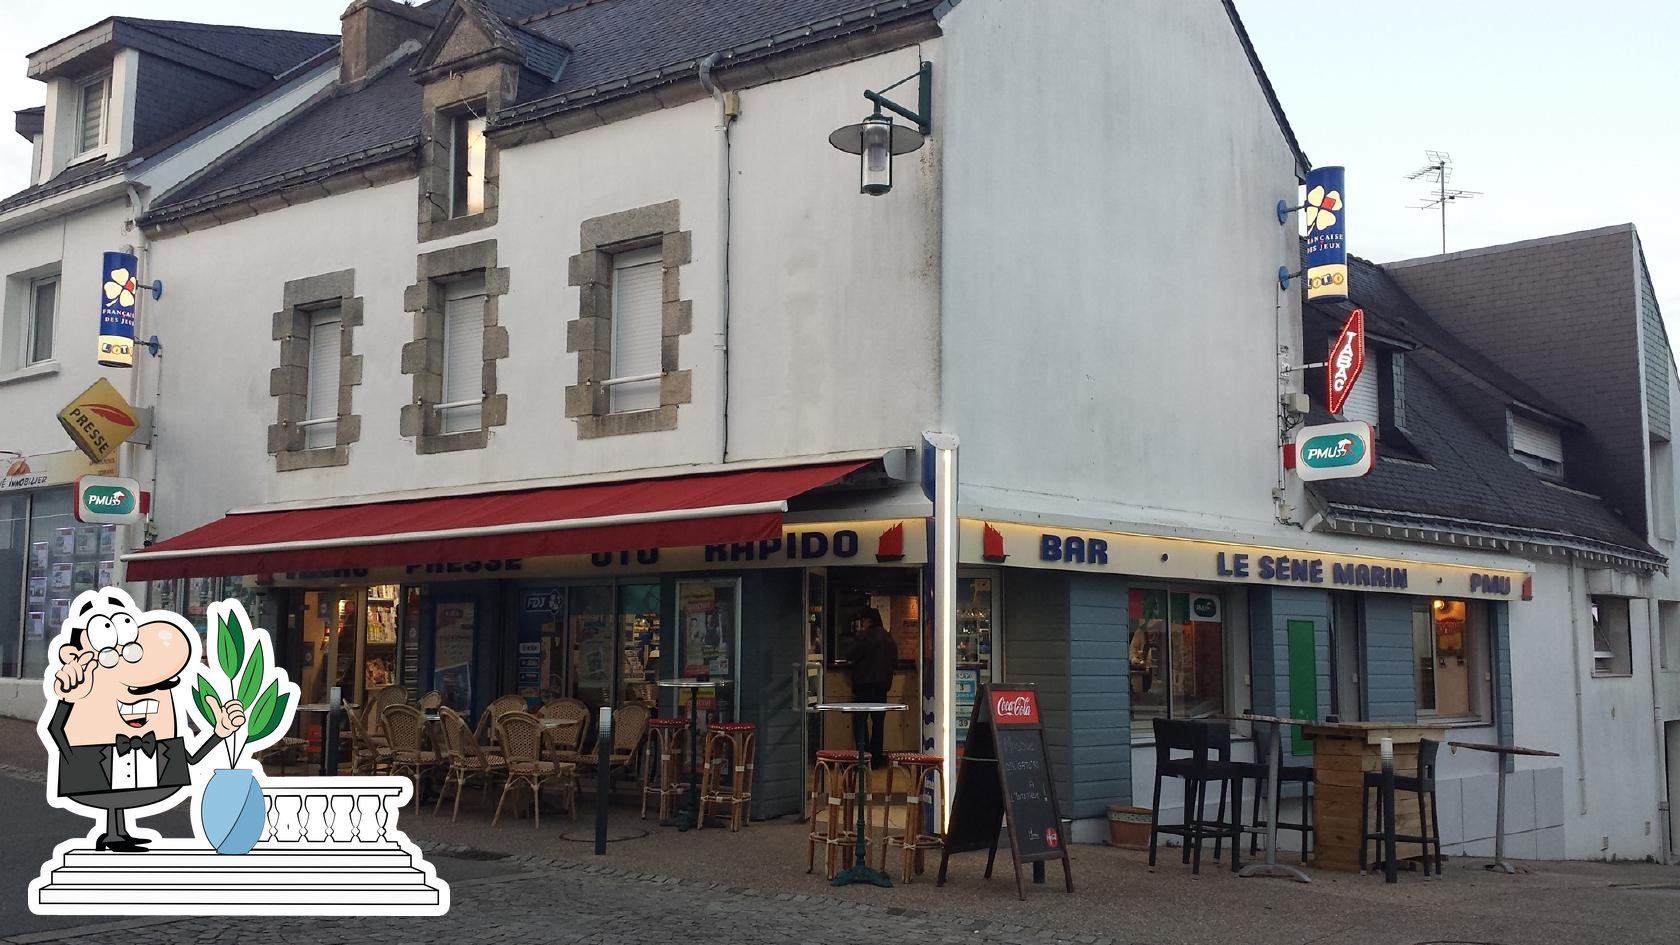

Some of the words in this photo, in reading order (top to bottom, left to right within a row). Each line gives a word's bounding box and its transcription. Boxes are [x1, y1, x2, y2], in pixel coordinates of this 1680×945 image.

[1319, 242, 1341, 251] JEUX
[1334, 331, 1355, 391] TABAC
[69, 407, 110, 455] PRESSE
[1307, 445, 1340, 460] PMU
[88, 495, 113, 506] PMU
[704, 530, 859, 562] RAPIDO
[1041, 534, 1109, 565] BAR
[1217, 551, 1250, 577] LE
[1332, 562, 1409, 589] MARIN
[1469, 573, 1511, 595] PMU
